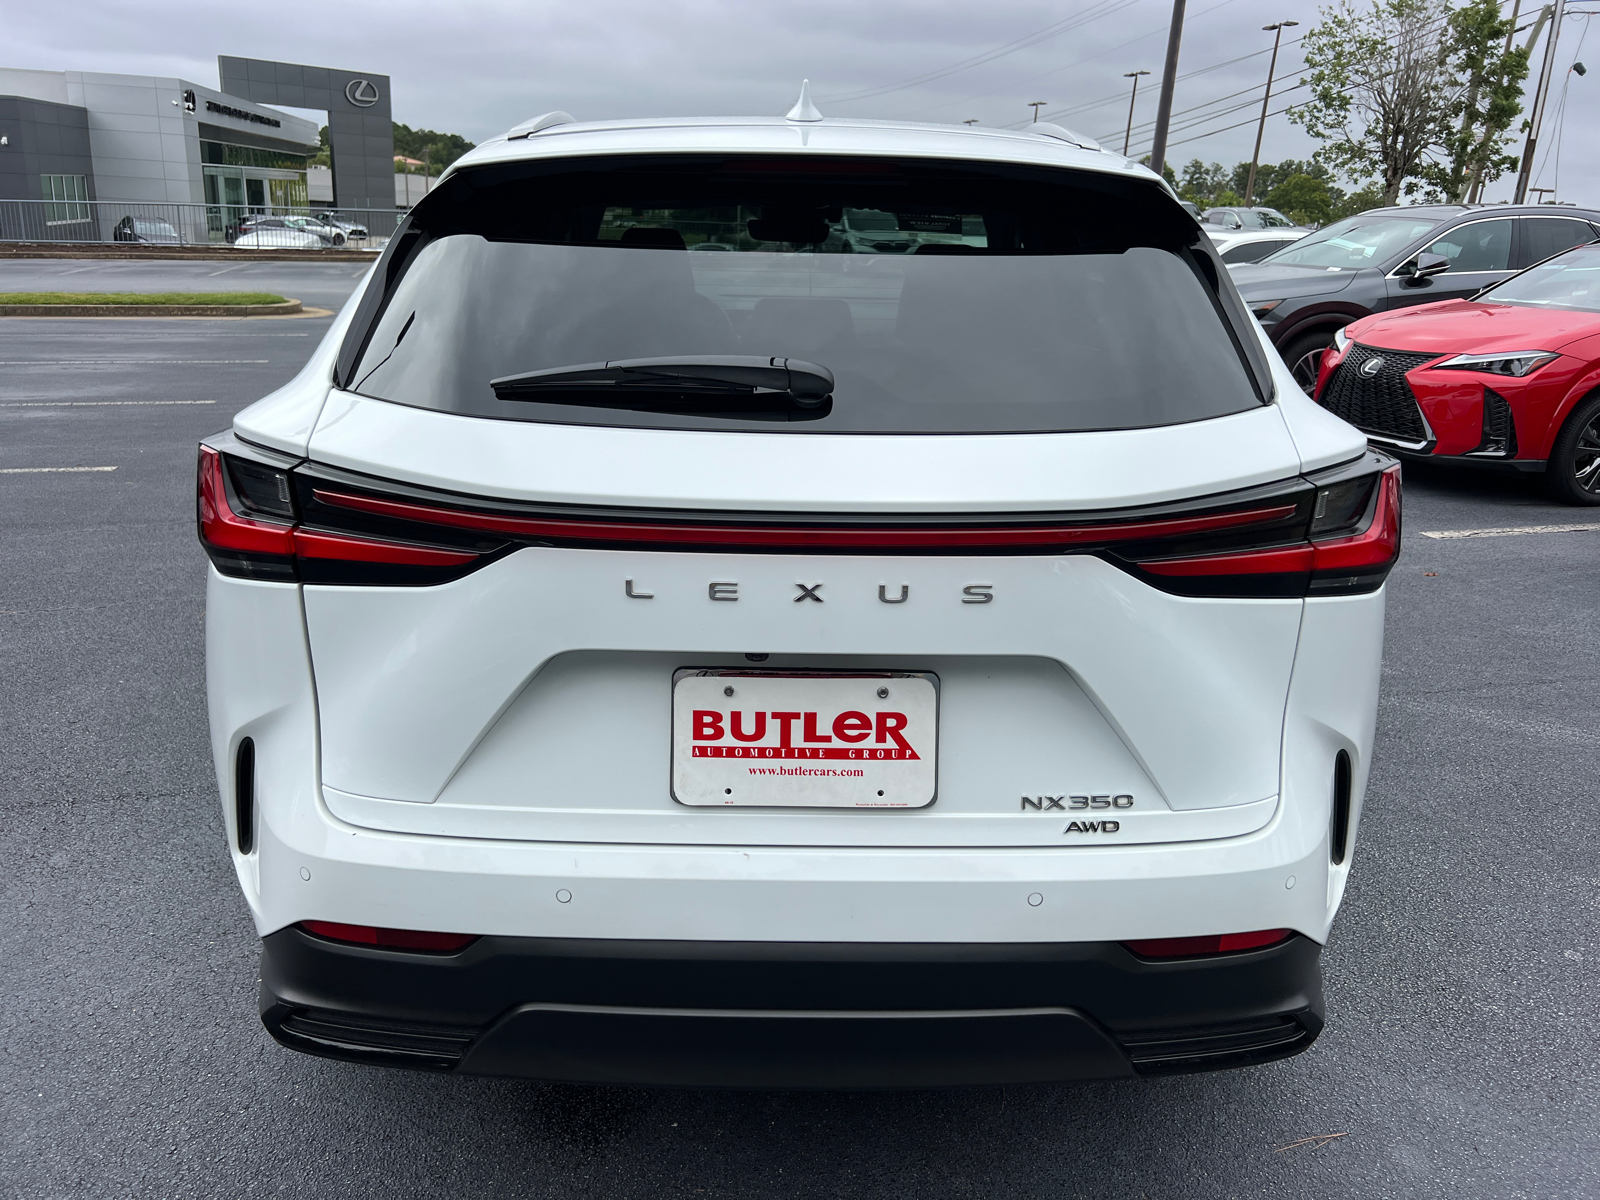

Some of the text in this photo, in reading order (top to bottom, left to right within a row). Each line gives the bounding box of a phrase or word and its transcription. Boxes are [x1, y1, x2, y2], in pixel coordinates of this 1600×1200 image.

[625, 577, 994, 604] LEXUS
[693, 747, 913, 759] AUTOMOTIVE GROUP
[748, 766, 864, 777] www.butlercars.com
[1021, 793, 1134, 811] NX350
[1063, 820, 1120, 834] AWD
